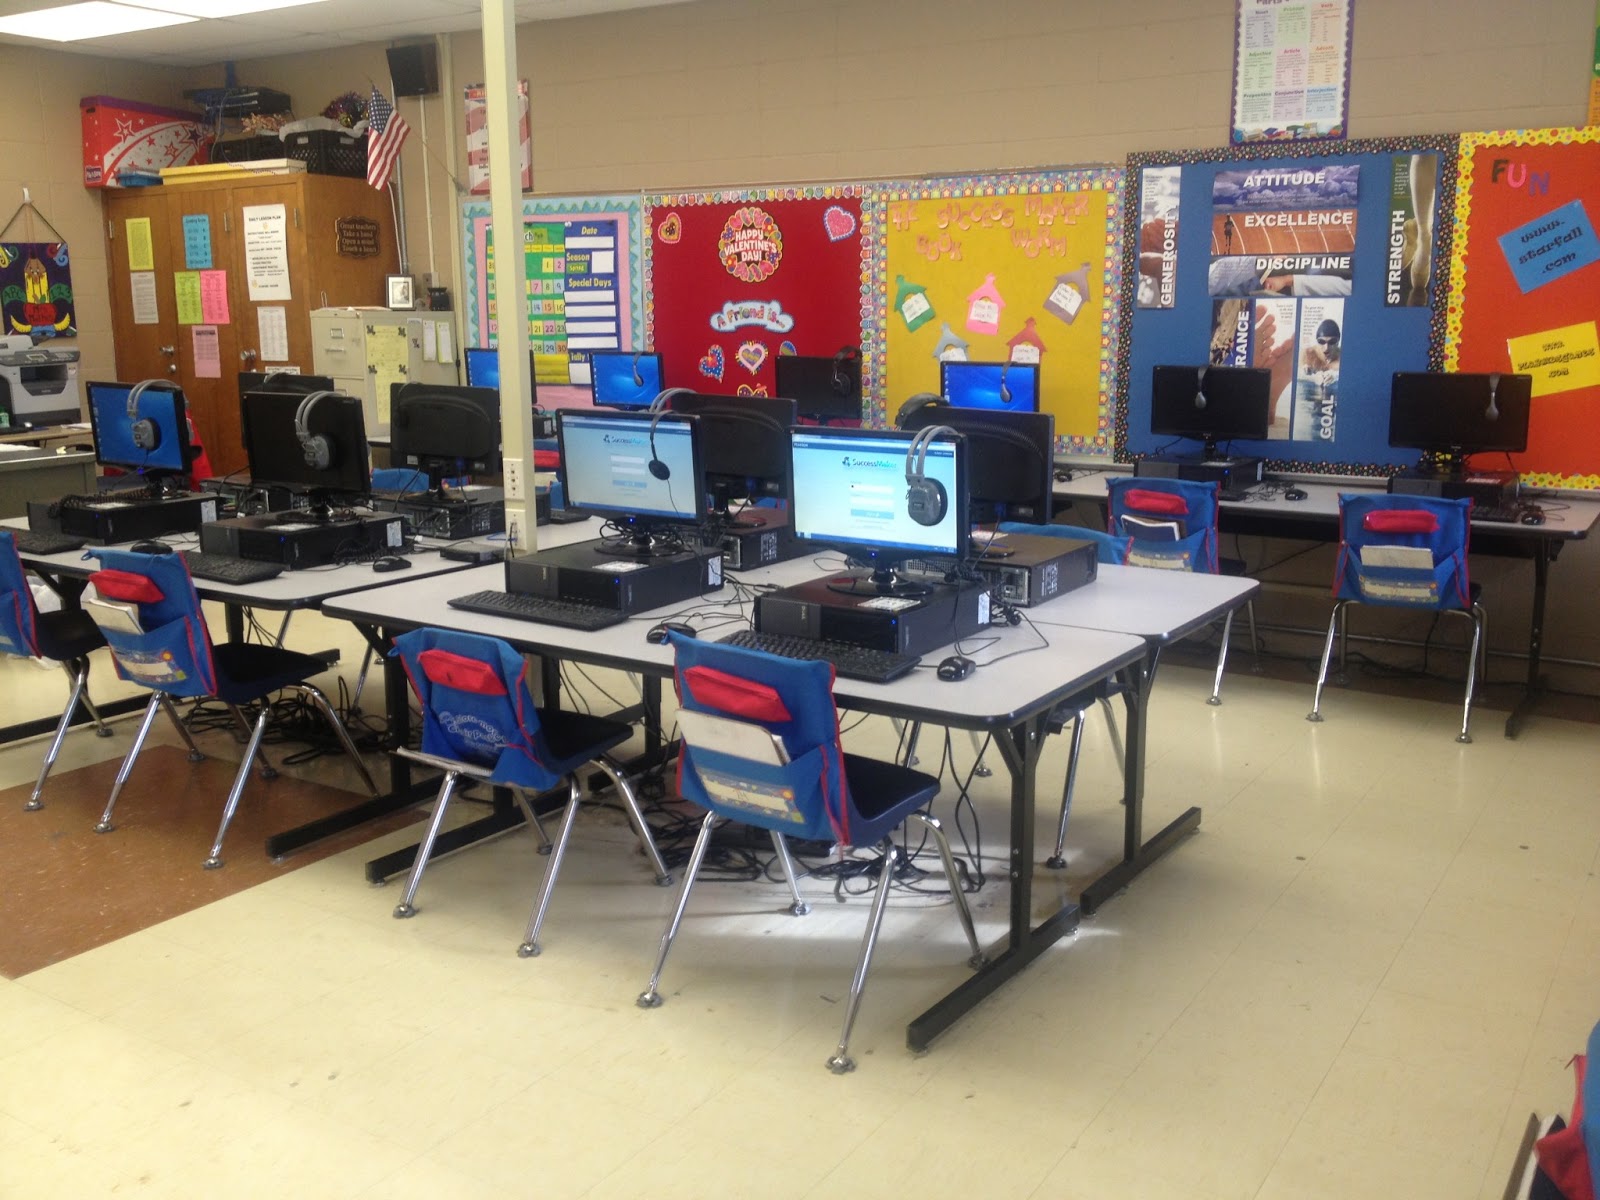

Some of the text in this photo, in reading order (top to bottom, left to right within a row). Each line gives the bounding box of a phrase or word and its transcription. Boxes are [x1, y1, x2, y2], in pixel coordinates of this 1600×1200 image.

[1243, 172, 1326, 188] ATTITUDE
[1491, 159, 1550, 197] FUN
[889, 194, 1089, 231] THE SUCCESS MAKER
[1244, 212, 1353, 228] EXCELLENCE
[581, 226, 598, 235] Date
[735, 229, 764, 241] HAPPY
[724, 241, 778, 256] VALENTINE'S
[915, 227, 1067, 262] BOOK WORM
[1519, 226, 1583, 265] starfall
[566, 252, 590, 261] Season
[741, 251, 762, 262] DAY!
[1256, 256, 1351, 270] DISCIPLINE
[1387, 210, 1406, 304] STRENGTH
[1542, 252, 1576, 274] .com
[568, 277, 612, 288] Special Days
[544, 303, 552, 312] 15
[534, 325, 541, 333] 21
[545, 325, 554, 333] 22
[557, 324, 565, 333] 23
[1235, 311, 1249, 368] RANCE
[557, 343, 566, 353] 30
[1320, 394, 1335, 440] GOAL
